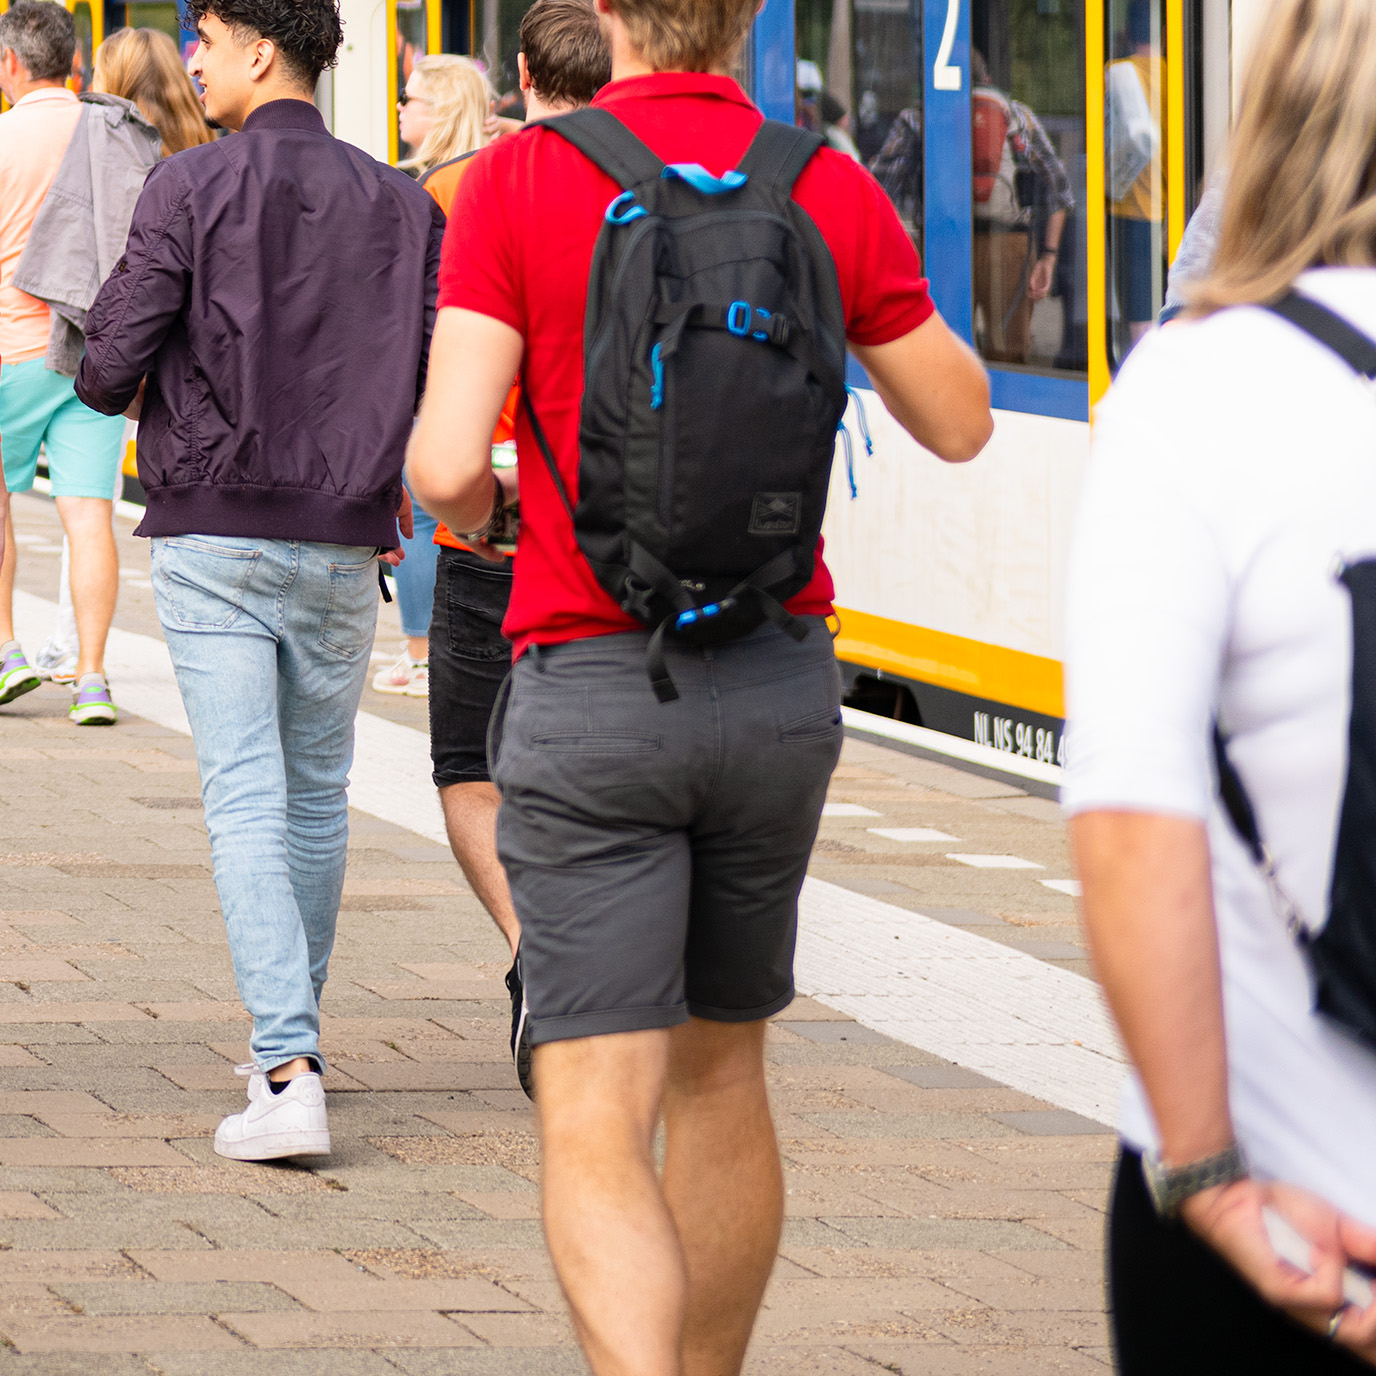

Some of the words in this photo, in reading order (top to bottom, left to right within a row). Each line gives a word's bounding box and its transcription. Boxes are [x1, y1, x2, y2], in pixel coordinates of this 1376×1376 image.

[973, 710, 993, 746] NL
[993, 716, 1014, 753] NS
[1015, 722, 1035, 758] 94
[1035, 727, 1055, 764] 84
